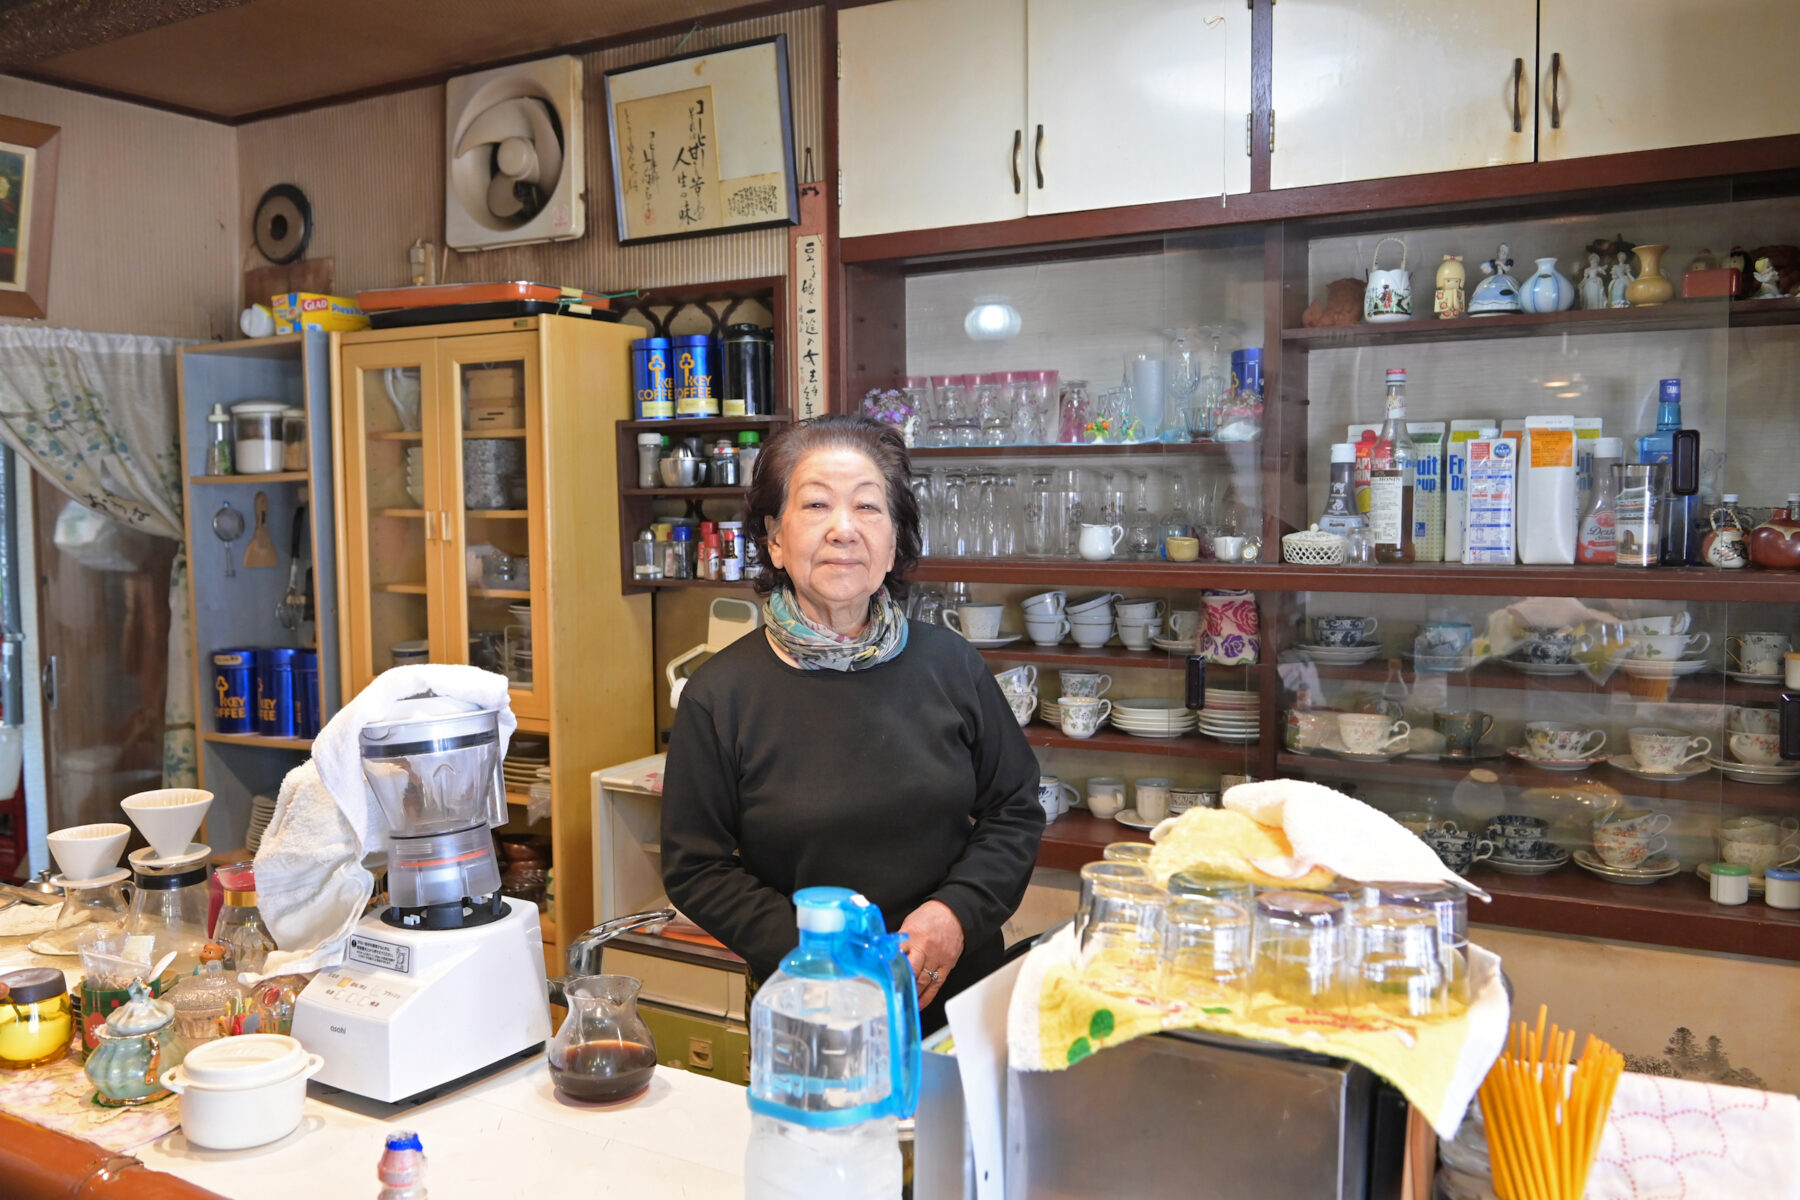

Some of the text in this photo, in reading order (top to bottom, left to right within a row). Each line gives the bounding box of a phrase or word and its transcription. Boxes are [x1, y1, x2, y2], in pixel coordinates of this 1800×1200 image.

[303, 299, 328, 311] GLAD
[638, 389, 673, 400] COFFE
[677, 386, 712, 399] OFFEE
